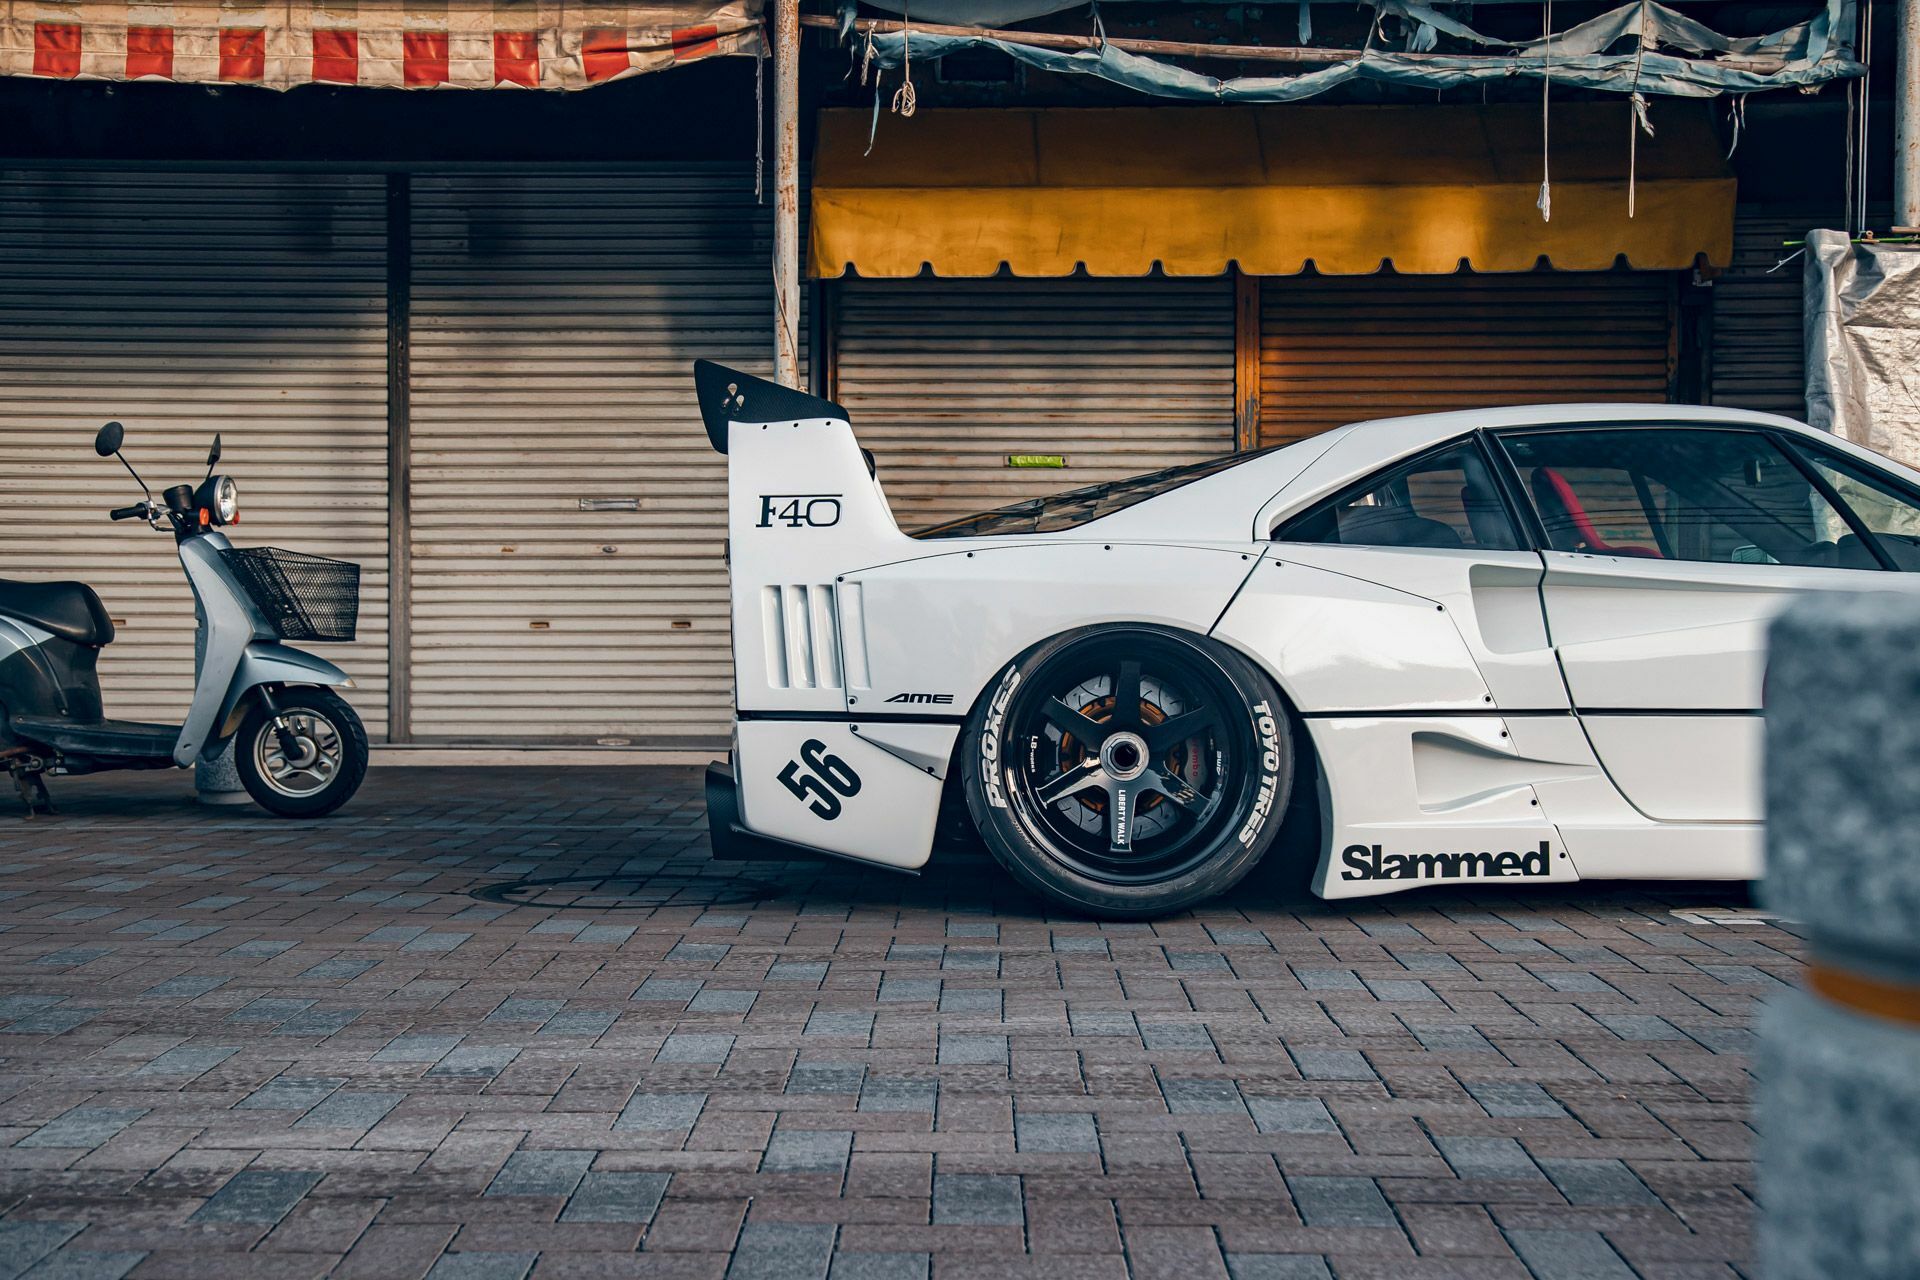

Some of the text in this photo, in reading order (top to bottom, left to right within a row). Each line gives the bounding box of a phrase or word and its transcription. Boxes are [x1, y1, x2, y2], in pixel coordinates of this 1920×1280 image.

[755, 494, 843, 527] F40
[884, 693, 954, 704] AME
[981, 664, 1021, 808] PROXES
[776, 738, 862, 821] 56
[1238, 700, 1280, 849] TOYO TIRES
[1341, 840, 1550, 881] Slammed
